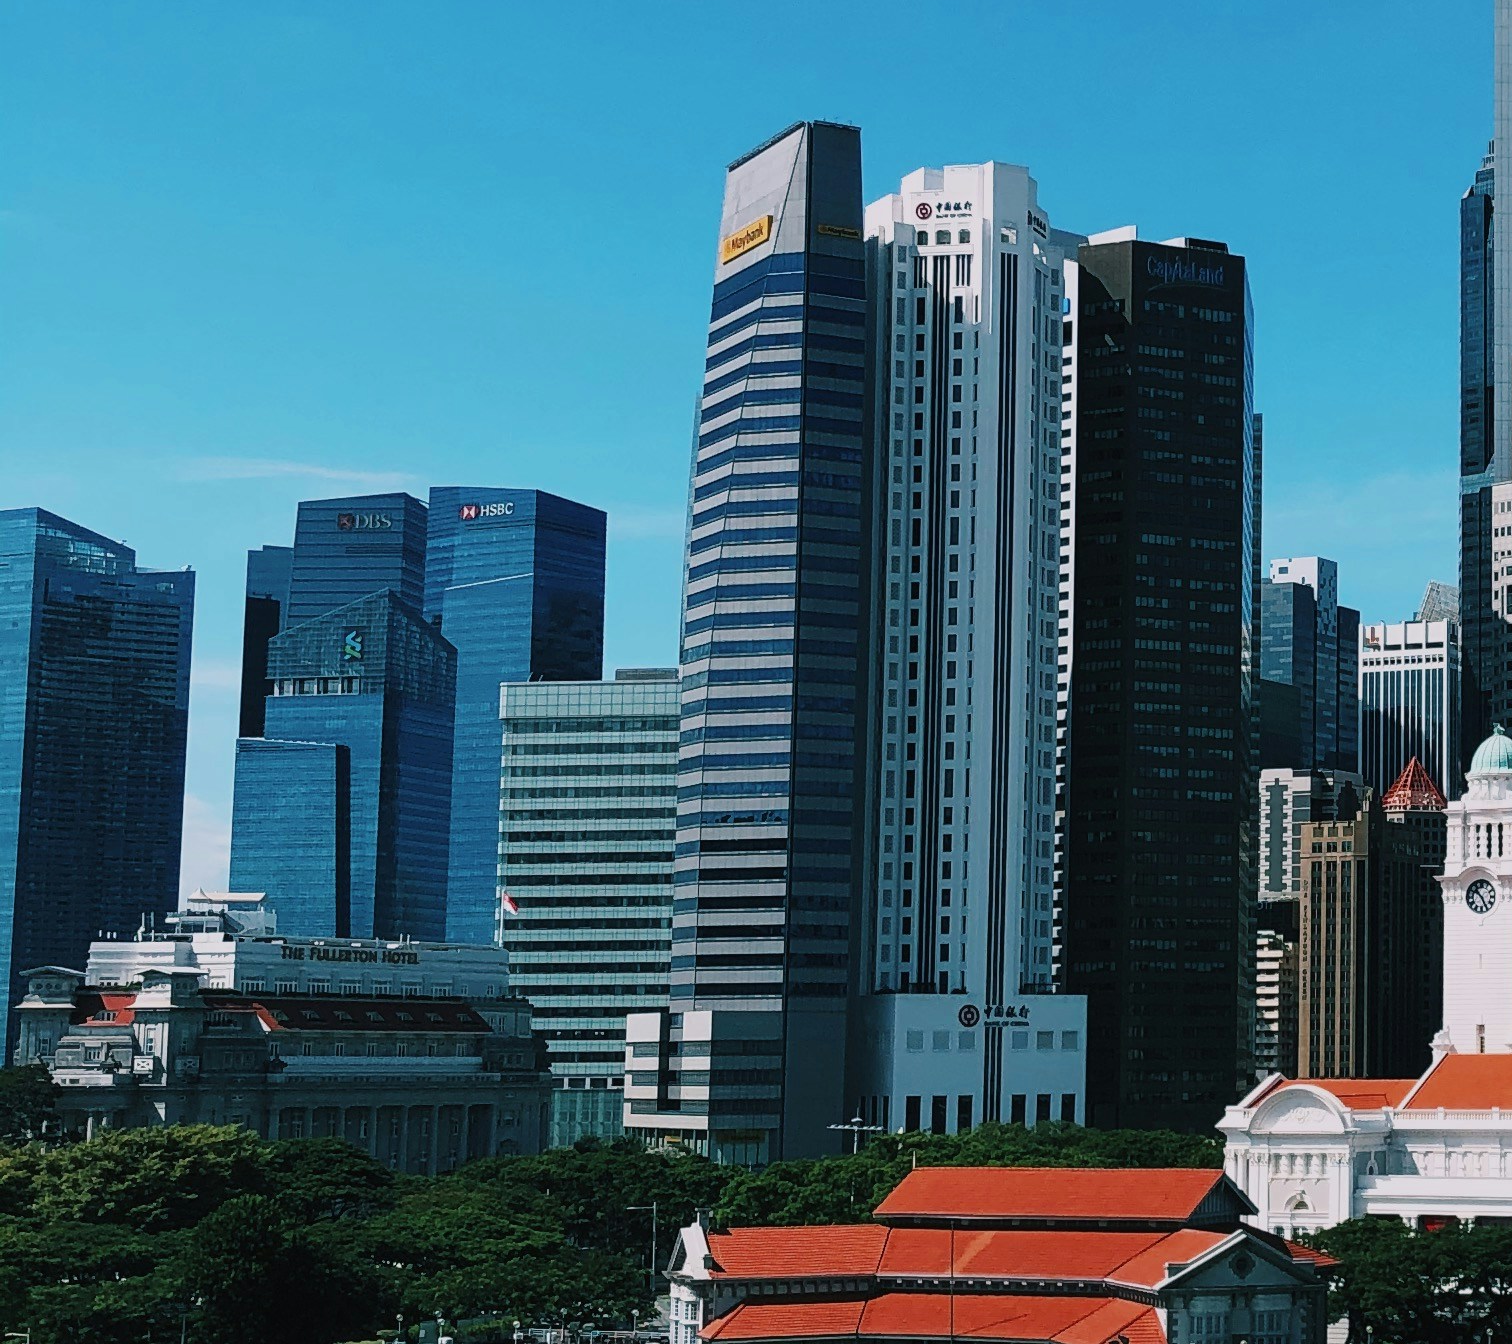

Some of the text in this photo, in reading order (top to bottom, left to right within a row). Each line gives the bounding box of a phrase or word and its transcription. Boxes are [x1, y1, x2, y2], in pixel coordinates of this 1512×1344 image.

[731, 222, 764, 251] Maybank
[480, 502, 514, 517] HSBC
[354, 513, 392, 529] DBS
[281, 946, 420, 965] THE FULLERTON HOTEL
